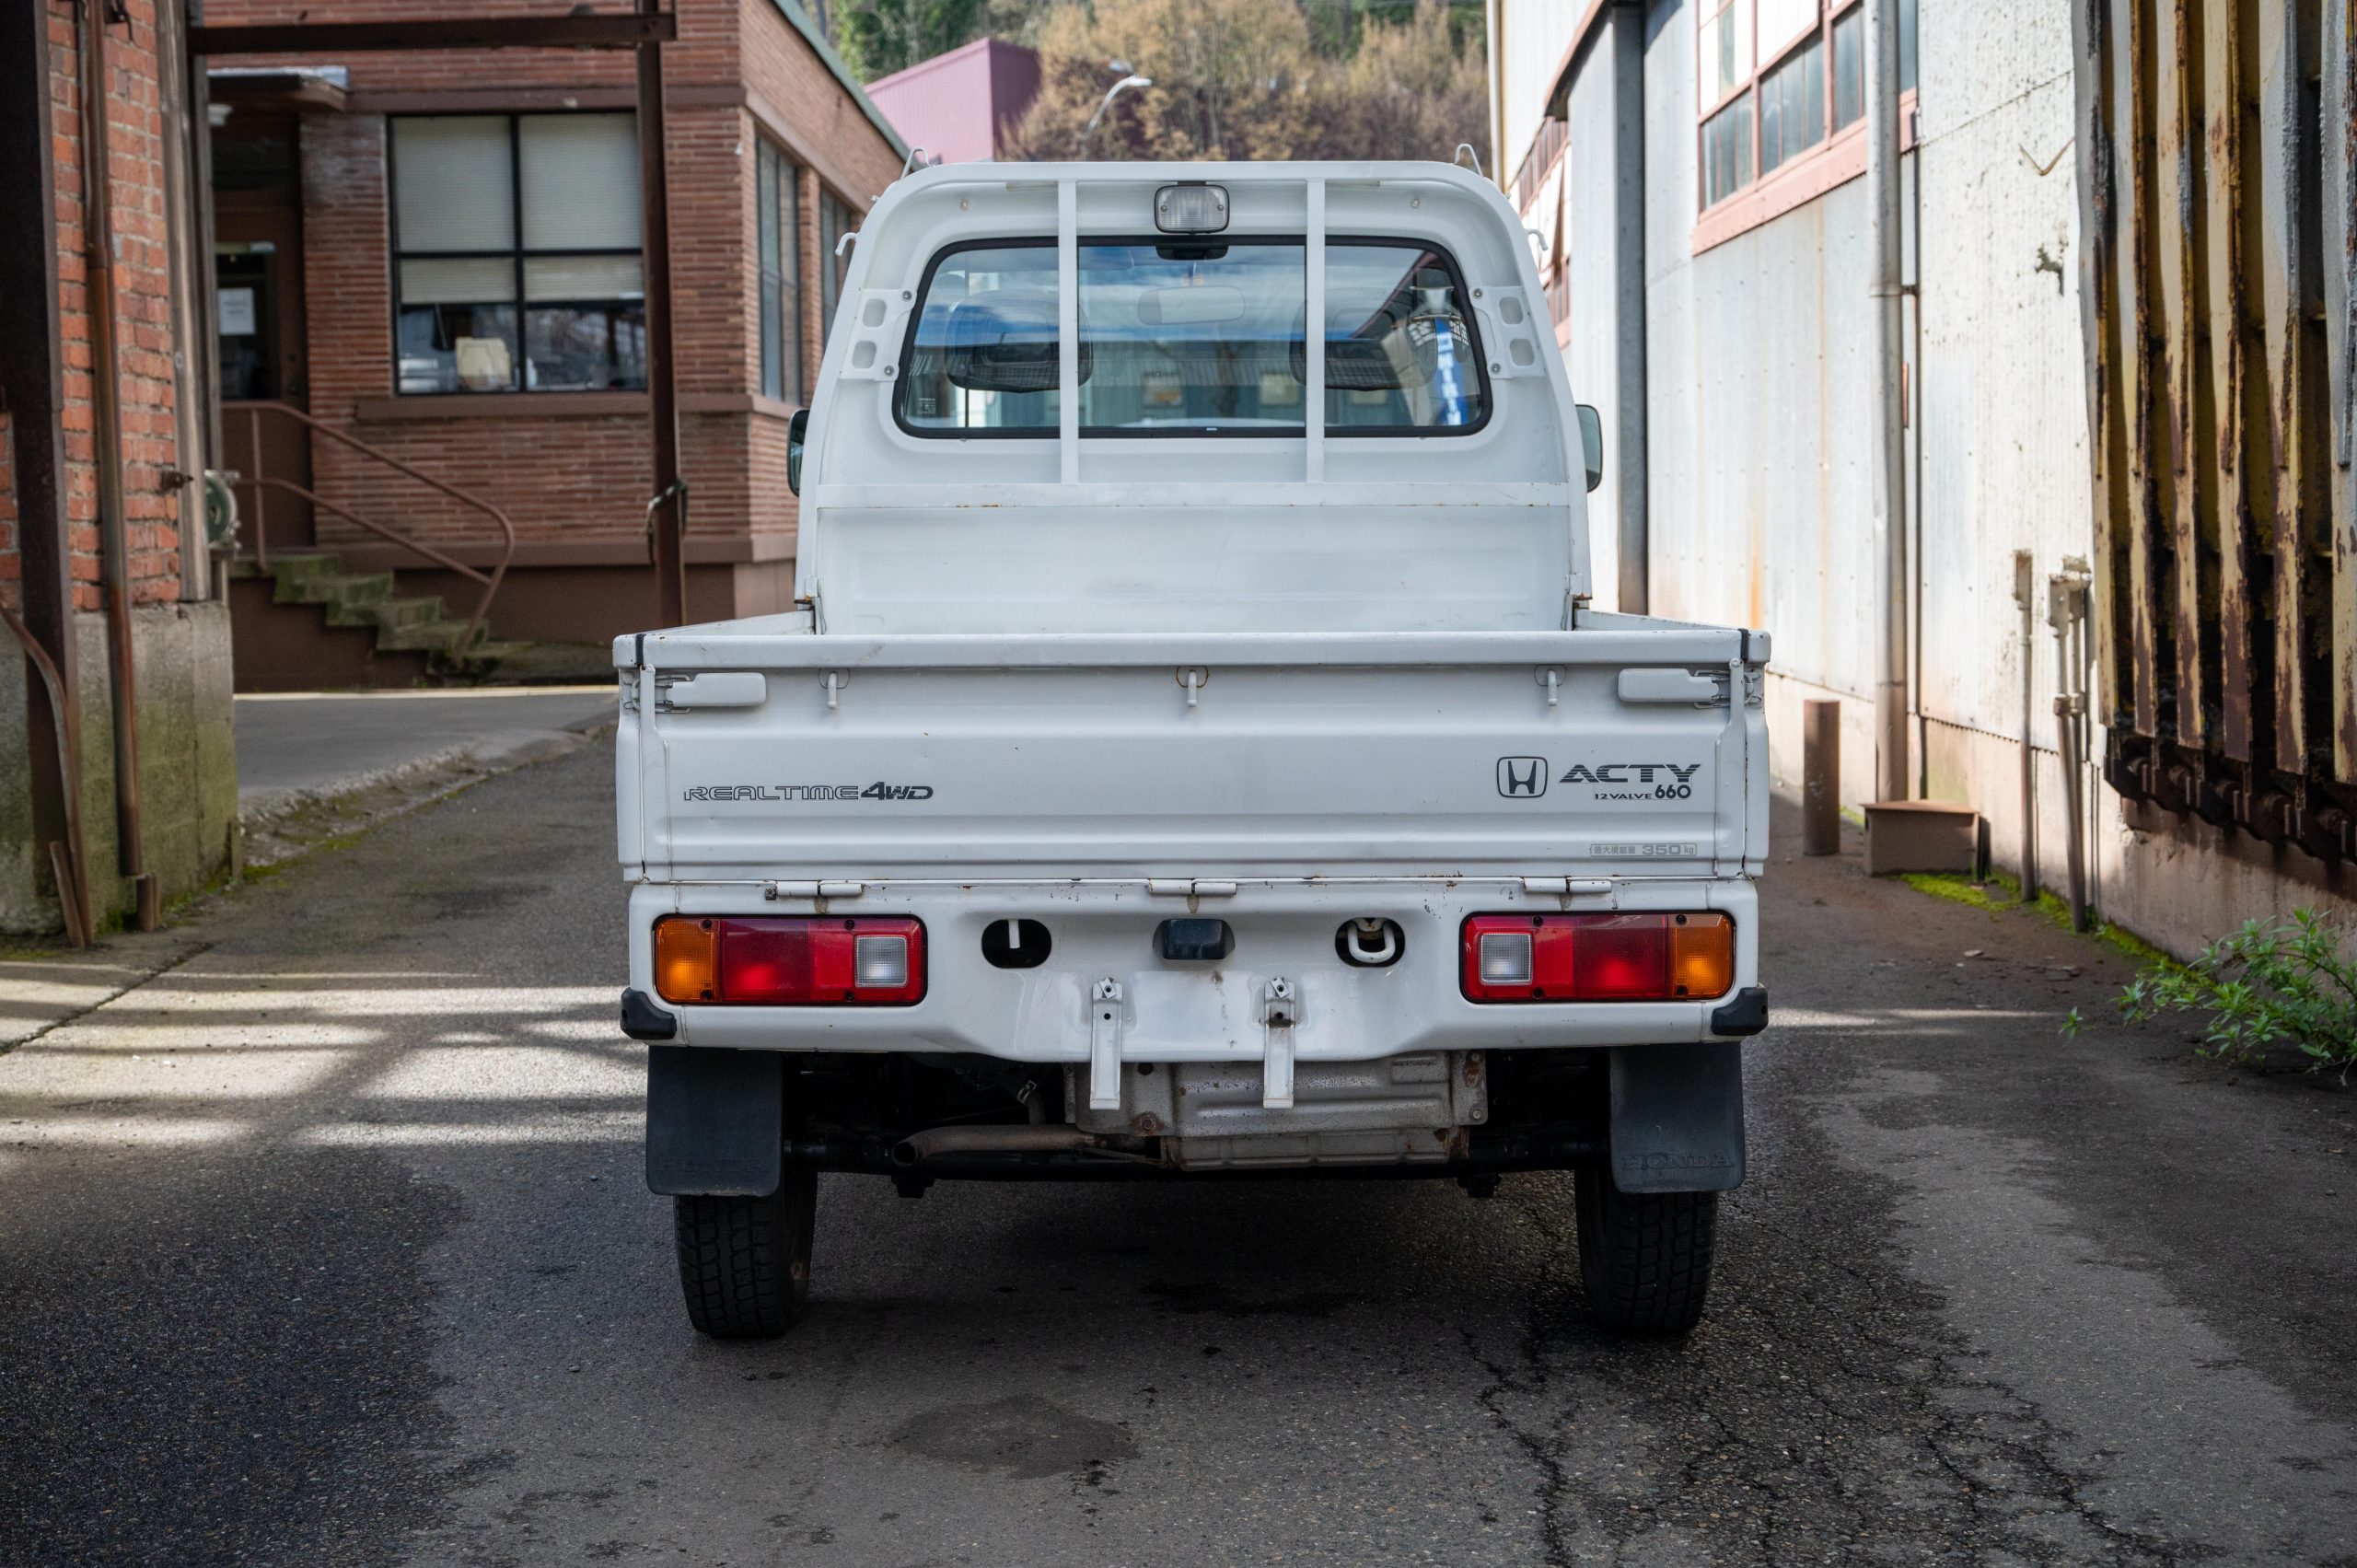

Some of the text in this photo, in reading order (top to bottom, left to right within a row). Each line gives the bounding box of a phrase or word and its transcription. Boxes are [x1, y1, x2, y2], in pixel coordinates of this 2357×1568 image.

[1559, 763, 1701, 783] ACTY
[1655, 784, 1691, 799] 660
[1642, 844, 1681, 855] 350
[1684, 845, 1694, 854] kg
